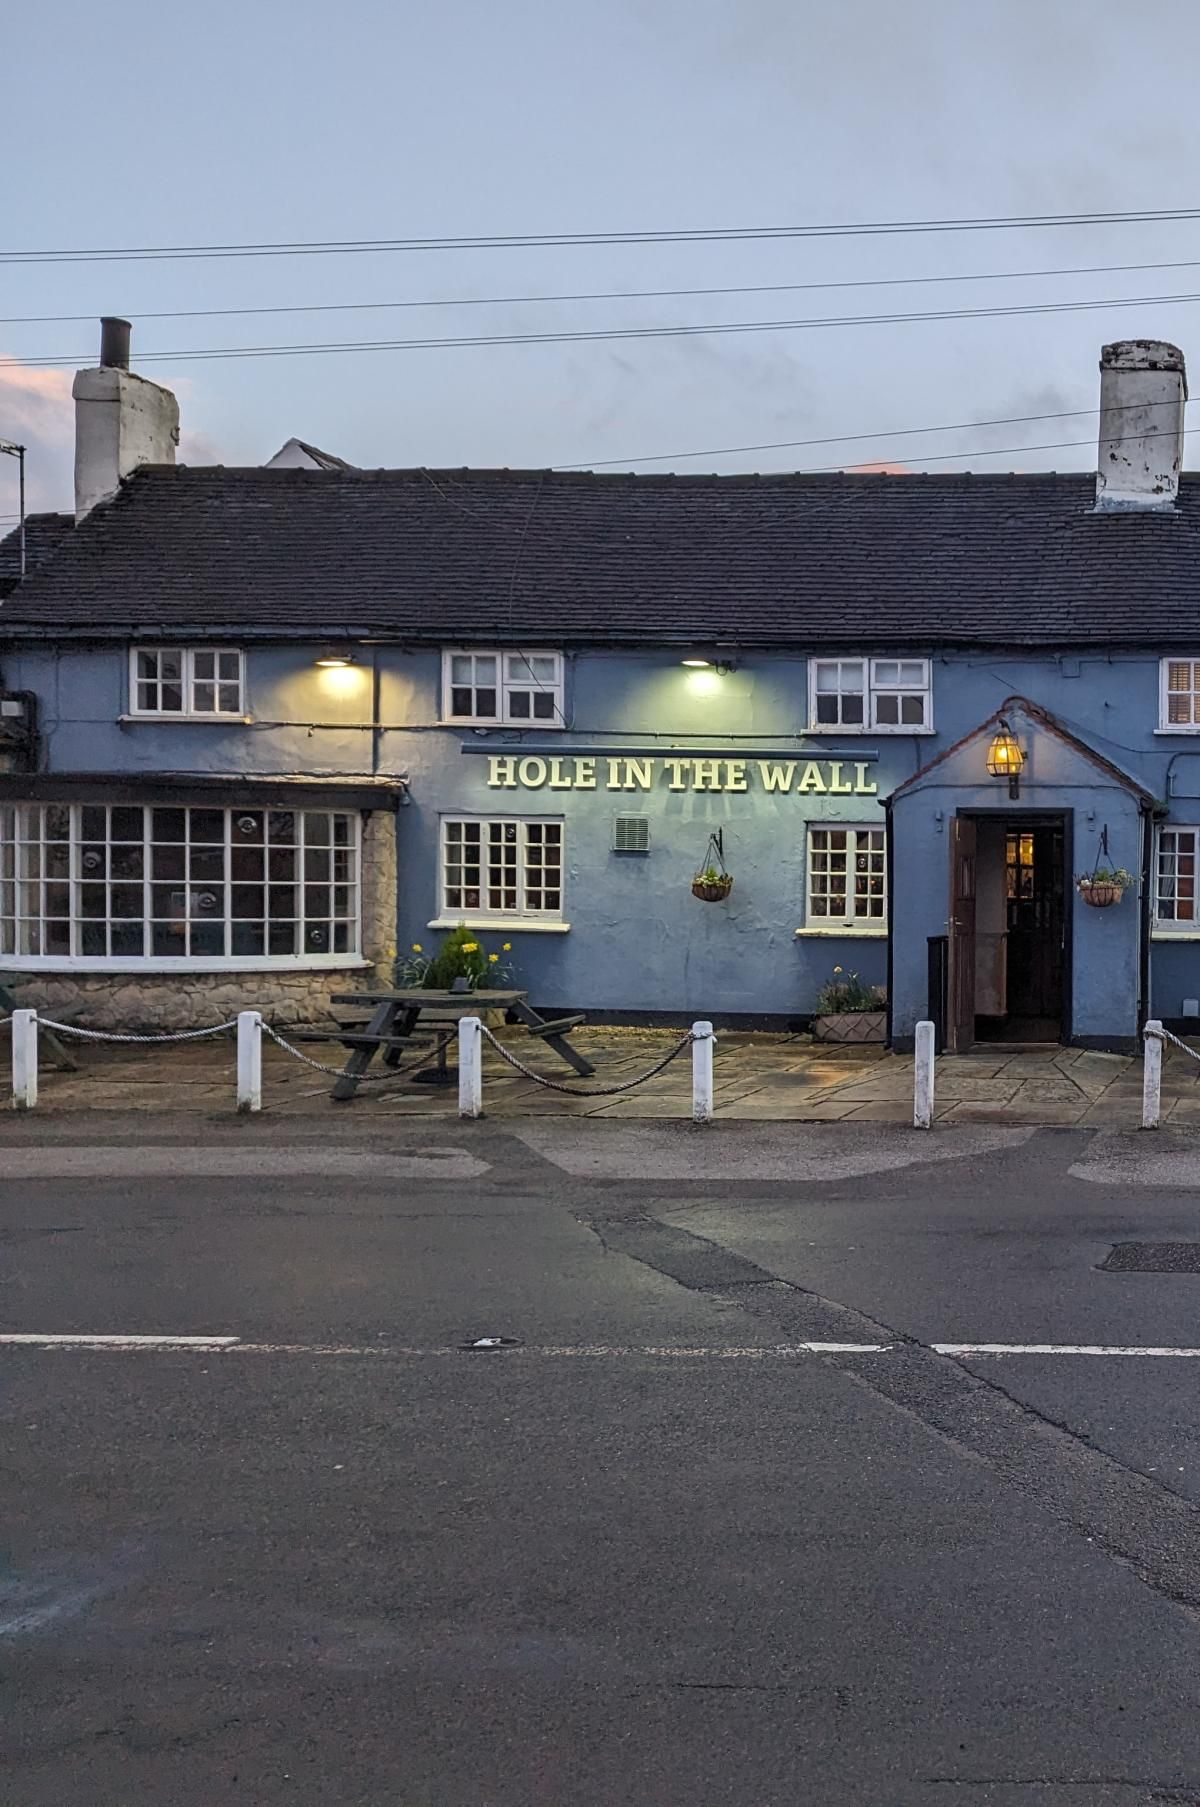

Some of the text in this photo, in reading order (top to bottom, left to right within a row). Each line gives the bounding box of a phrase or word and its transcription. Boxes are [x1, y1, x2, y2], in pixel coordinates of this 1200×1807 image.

[487, 755, 878, 793] HOLE IN THE WALL
